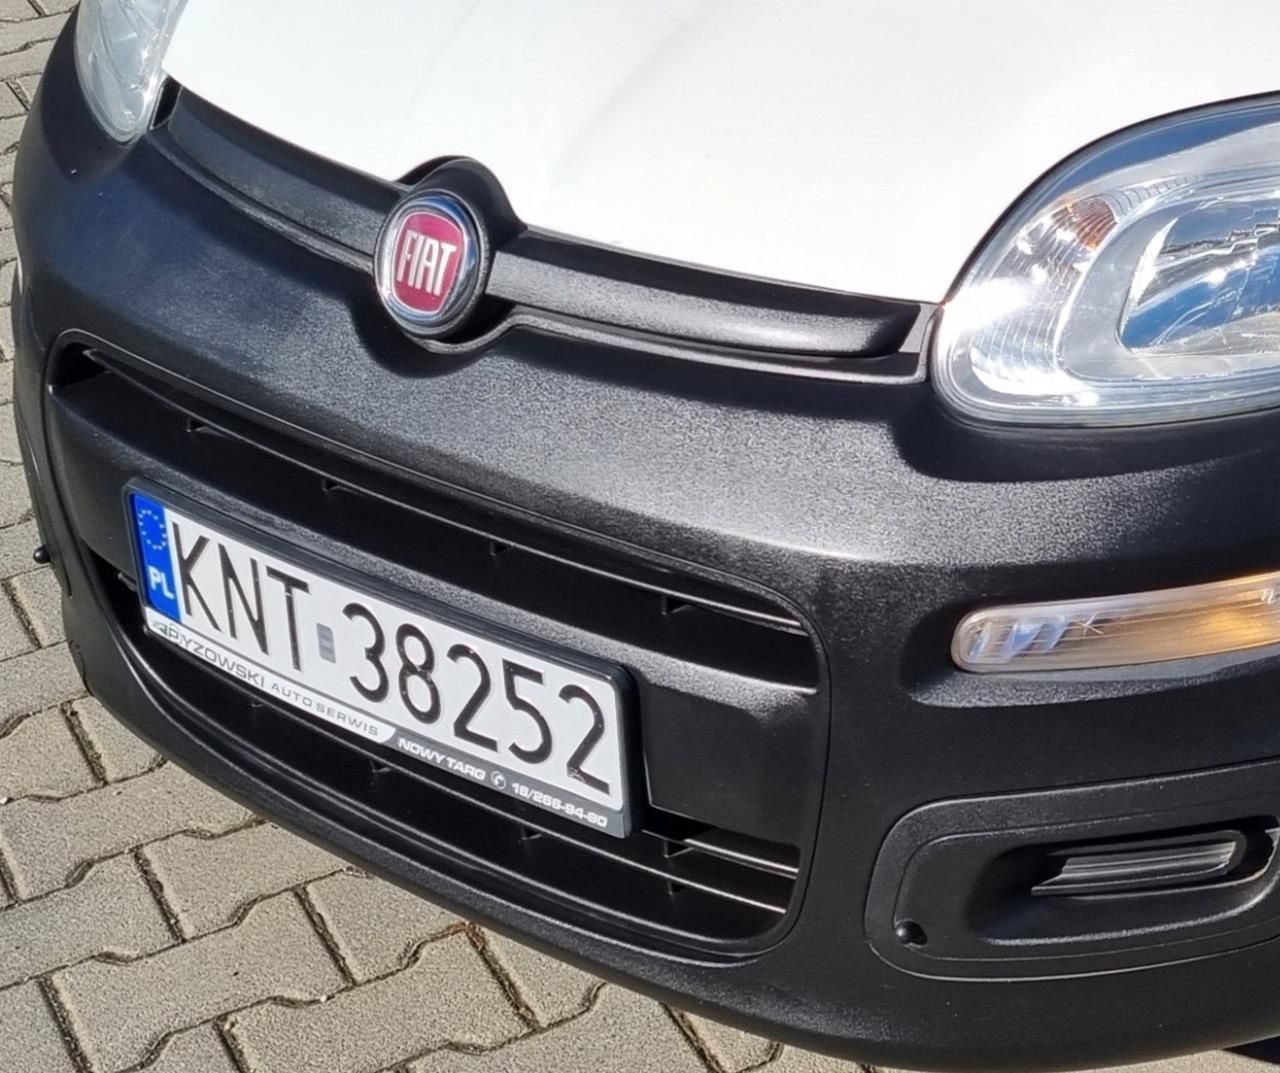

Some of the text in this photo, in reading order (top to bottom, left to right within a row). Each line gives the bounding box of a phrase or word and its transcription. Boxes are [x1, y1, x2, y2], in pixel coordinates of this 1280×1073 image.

[396, 228, 458, 297] FIAT
[148, 564, 175, 600] PL
[172, 522, 612, 796] KNT 38252
[270, 682, 313, 708] AUTO
[315, 702, 379, 737] SERWIS
[399, 739, 446, 764] NOWY
